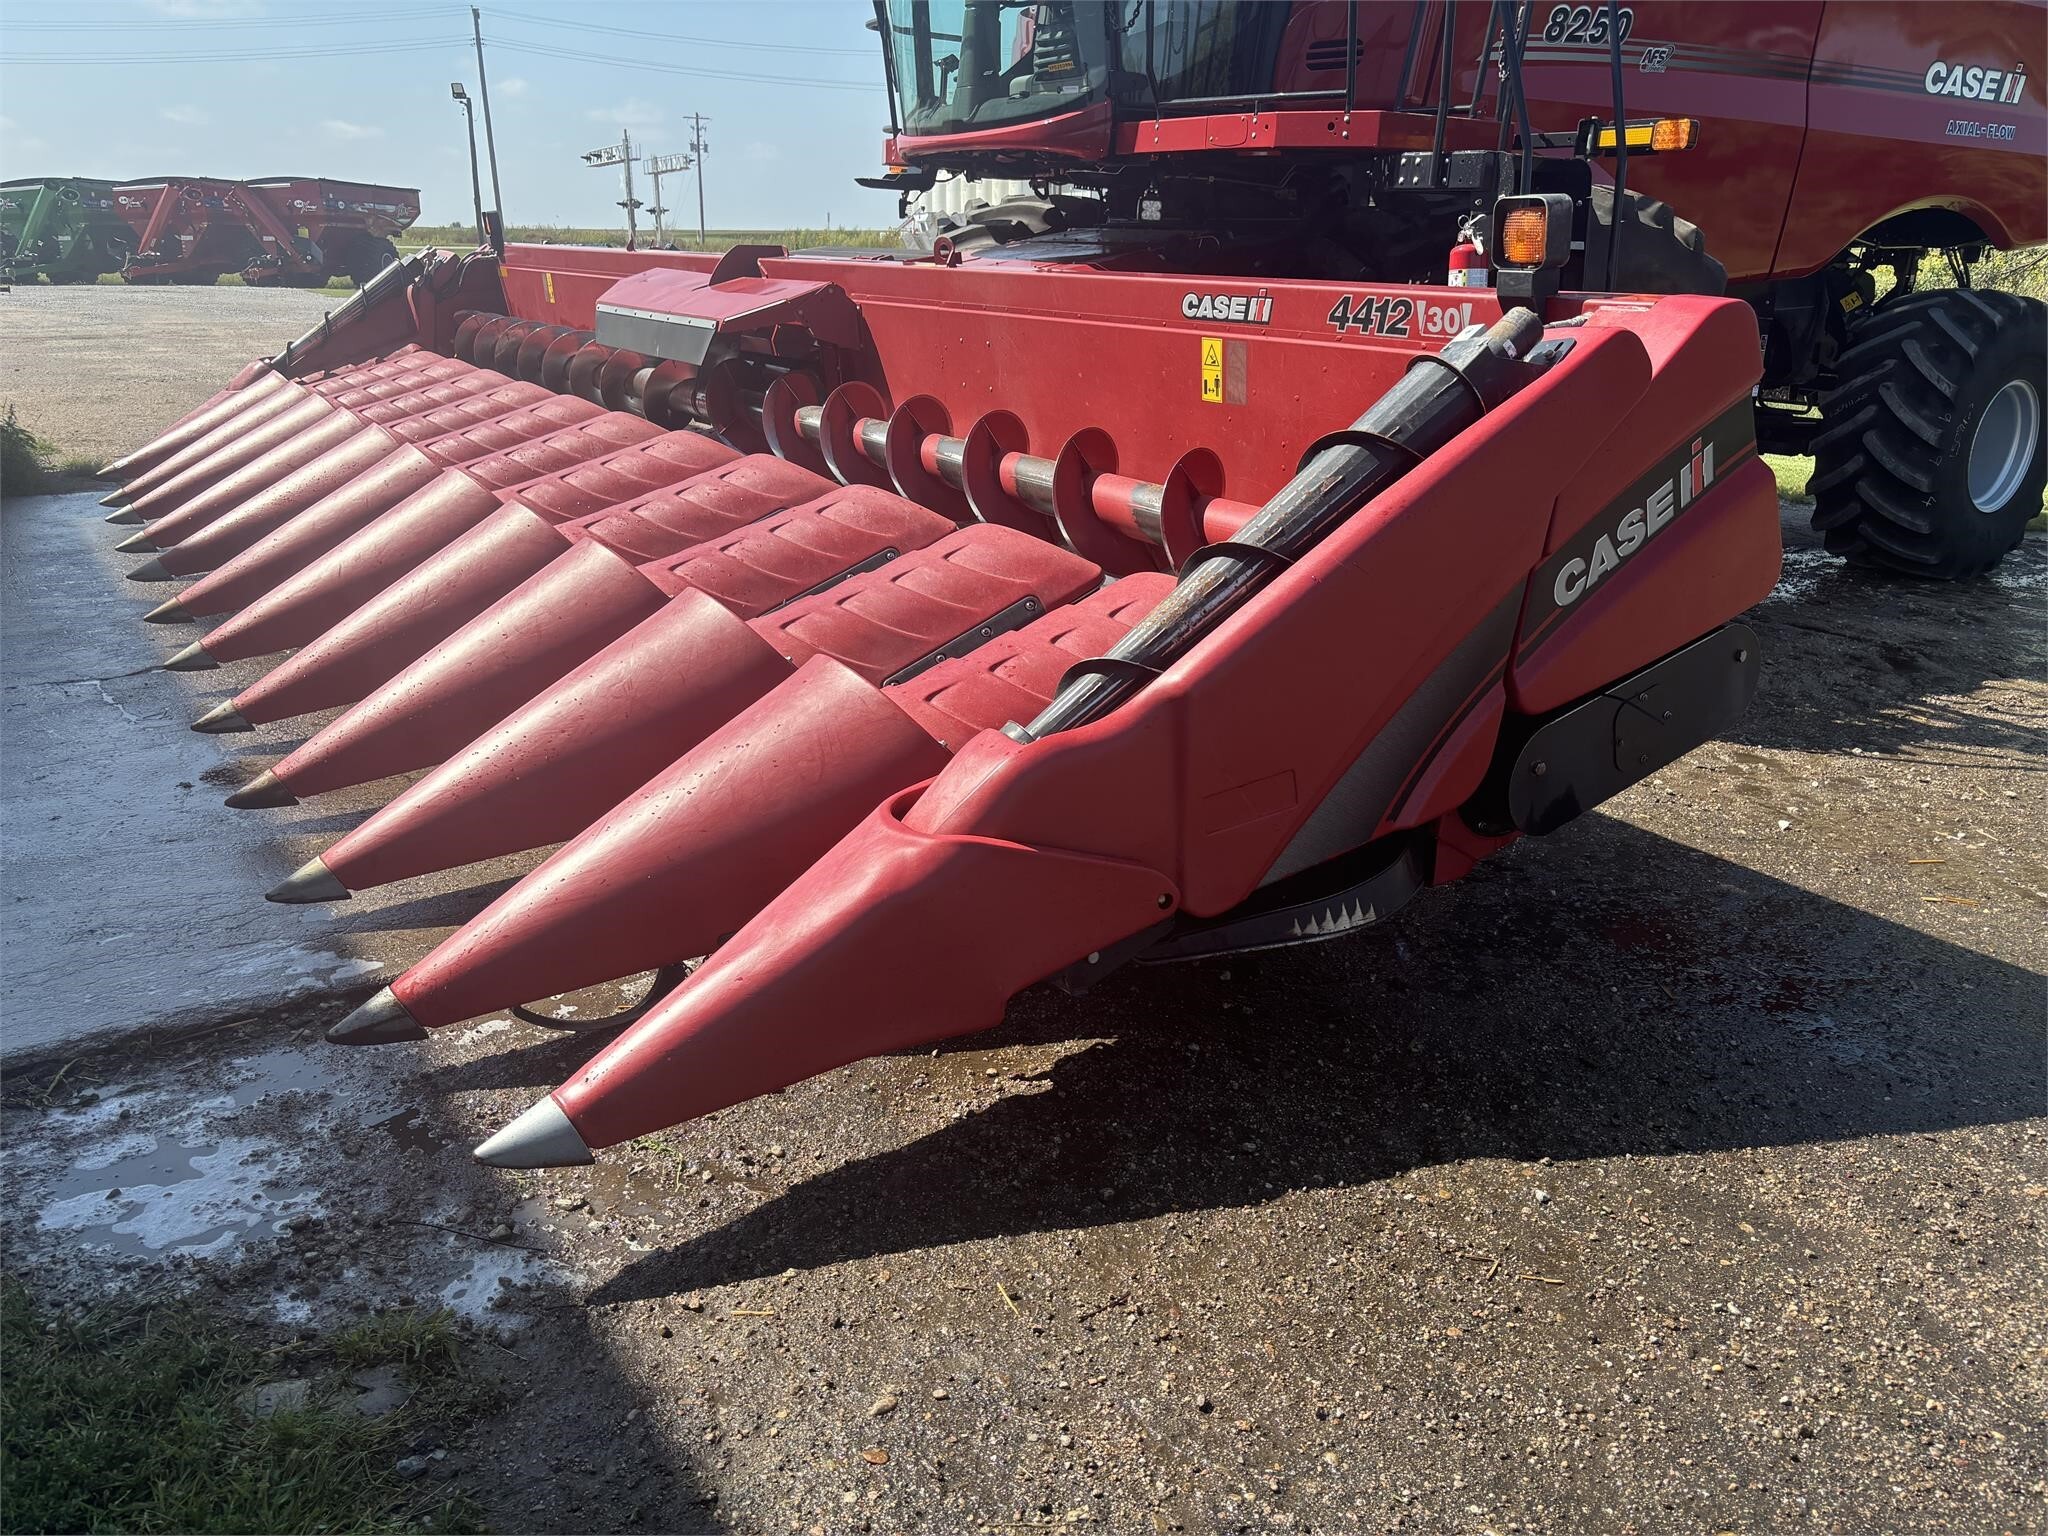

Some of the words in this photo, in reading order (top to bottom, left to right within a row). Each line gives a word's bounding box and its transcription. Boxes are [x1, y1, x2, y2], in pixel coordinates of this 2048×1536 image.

[1543, 4, 1634, 46] 8250
[1640, 46, 1669, 64] AFS
[1925, 61, 2003, 100] CASE
[1945, 119, 2016, 140] AXIAL-FLOW
[1182, 292, 1248, 321] CASE
[1326, 294, 1413, 337] 4412
[1426, 306, 1458, 334] 30
[1553, 478, 1675, 607] CASE
